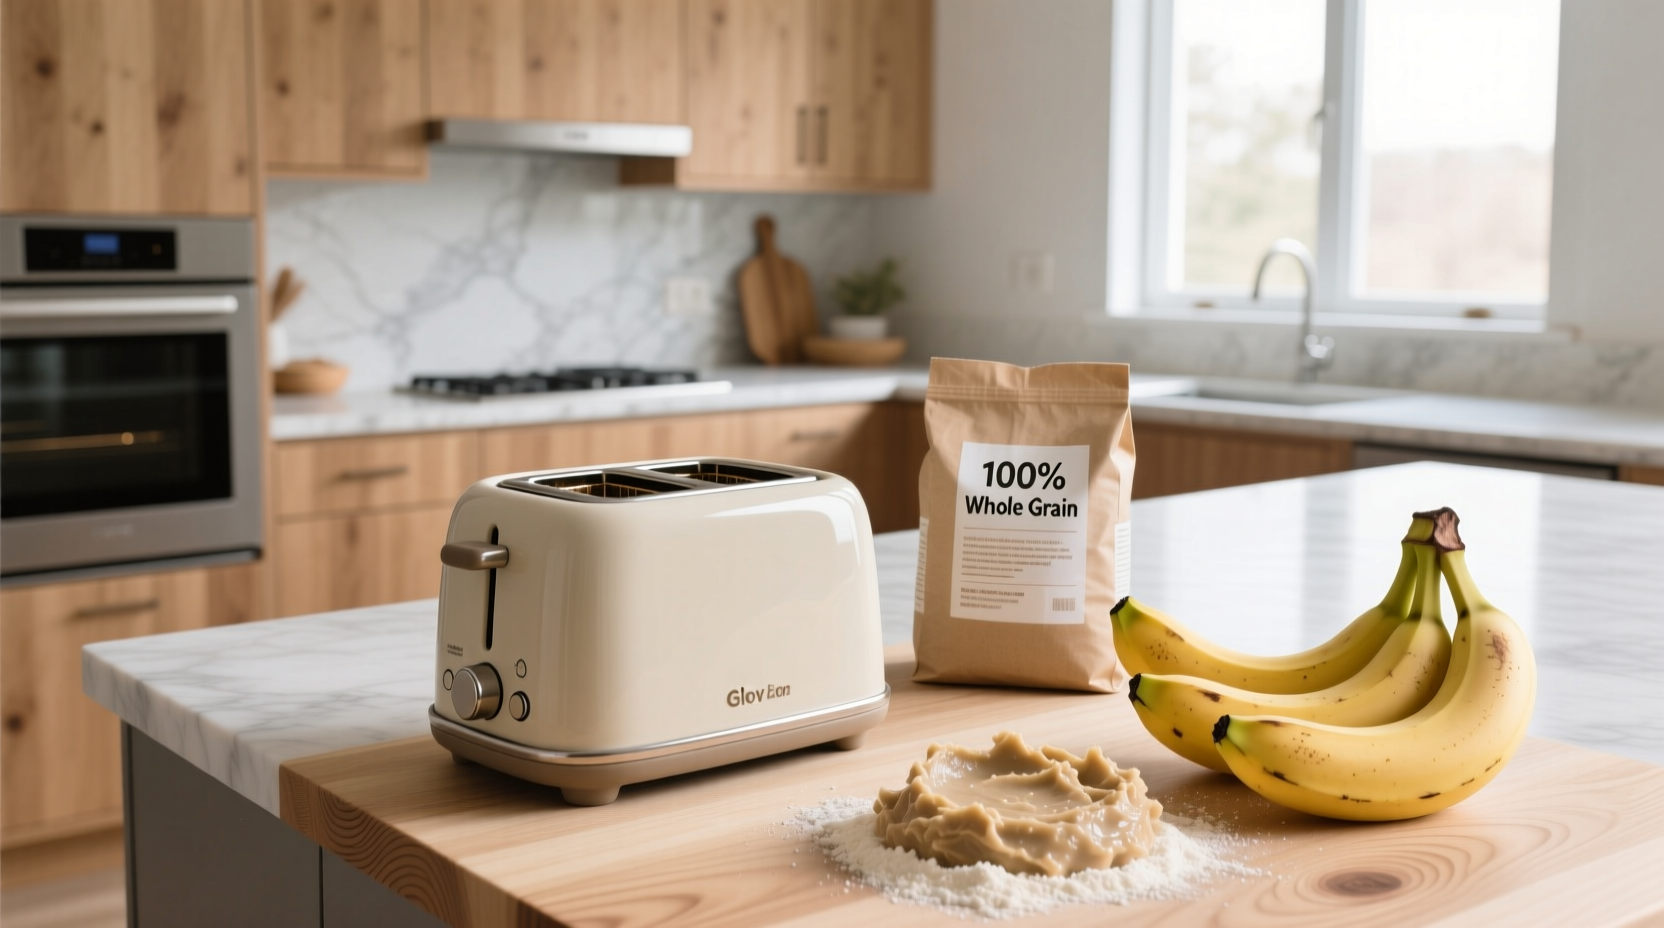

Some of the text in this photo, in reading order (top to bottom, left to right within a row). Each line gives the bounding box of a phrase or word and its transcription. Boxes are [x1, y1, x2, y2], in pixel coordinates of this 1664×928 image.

[982, 460, 1066, 490] 100%
[965, 494, 1078, 518] Whole Grain
[726, 686, 765, 708] Glov
